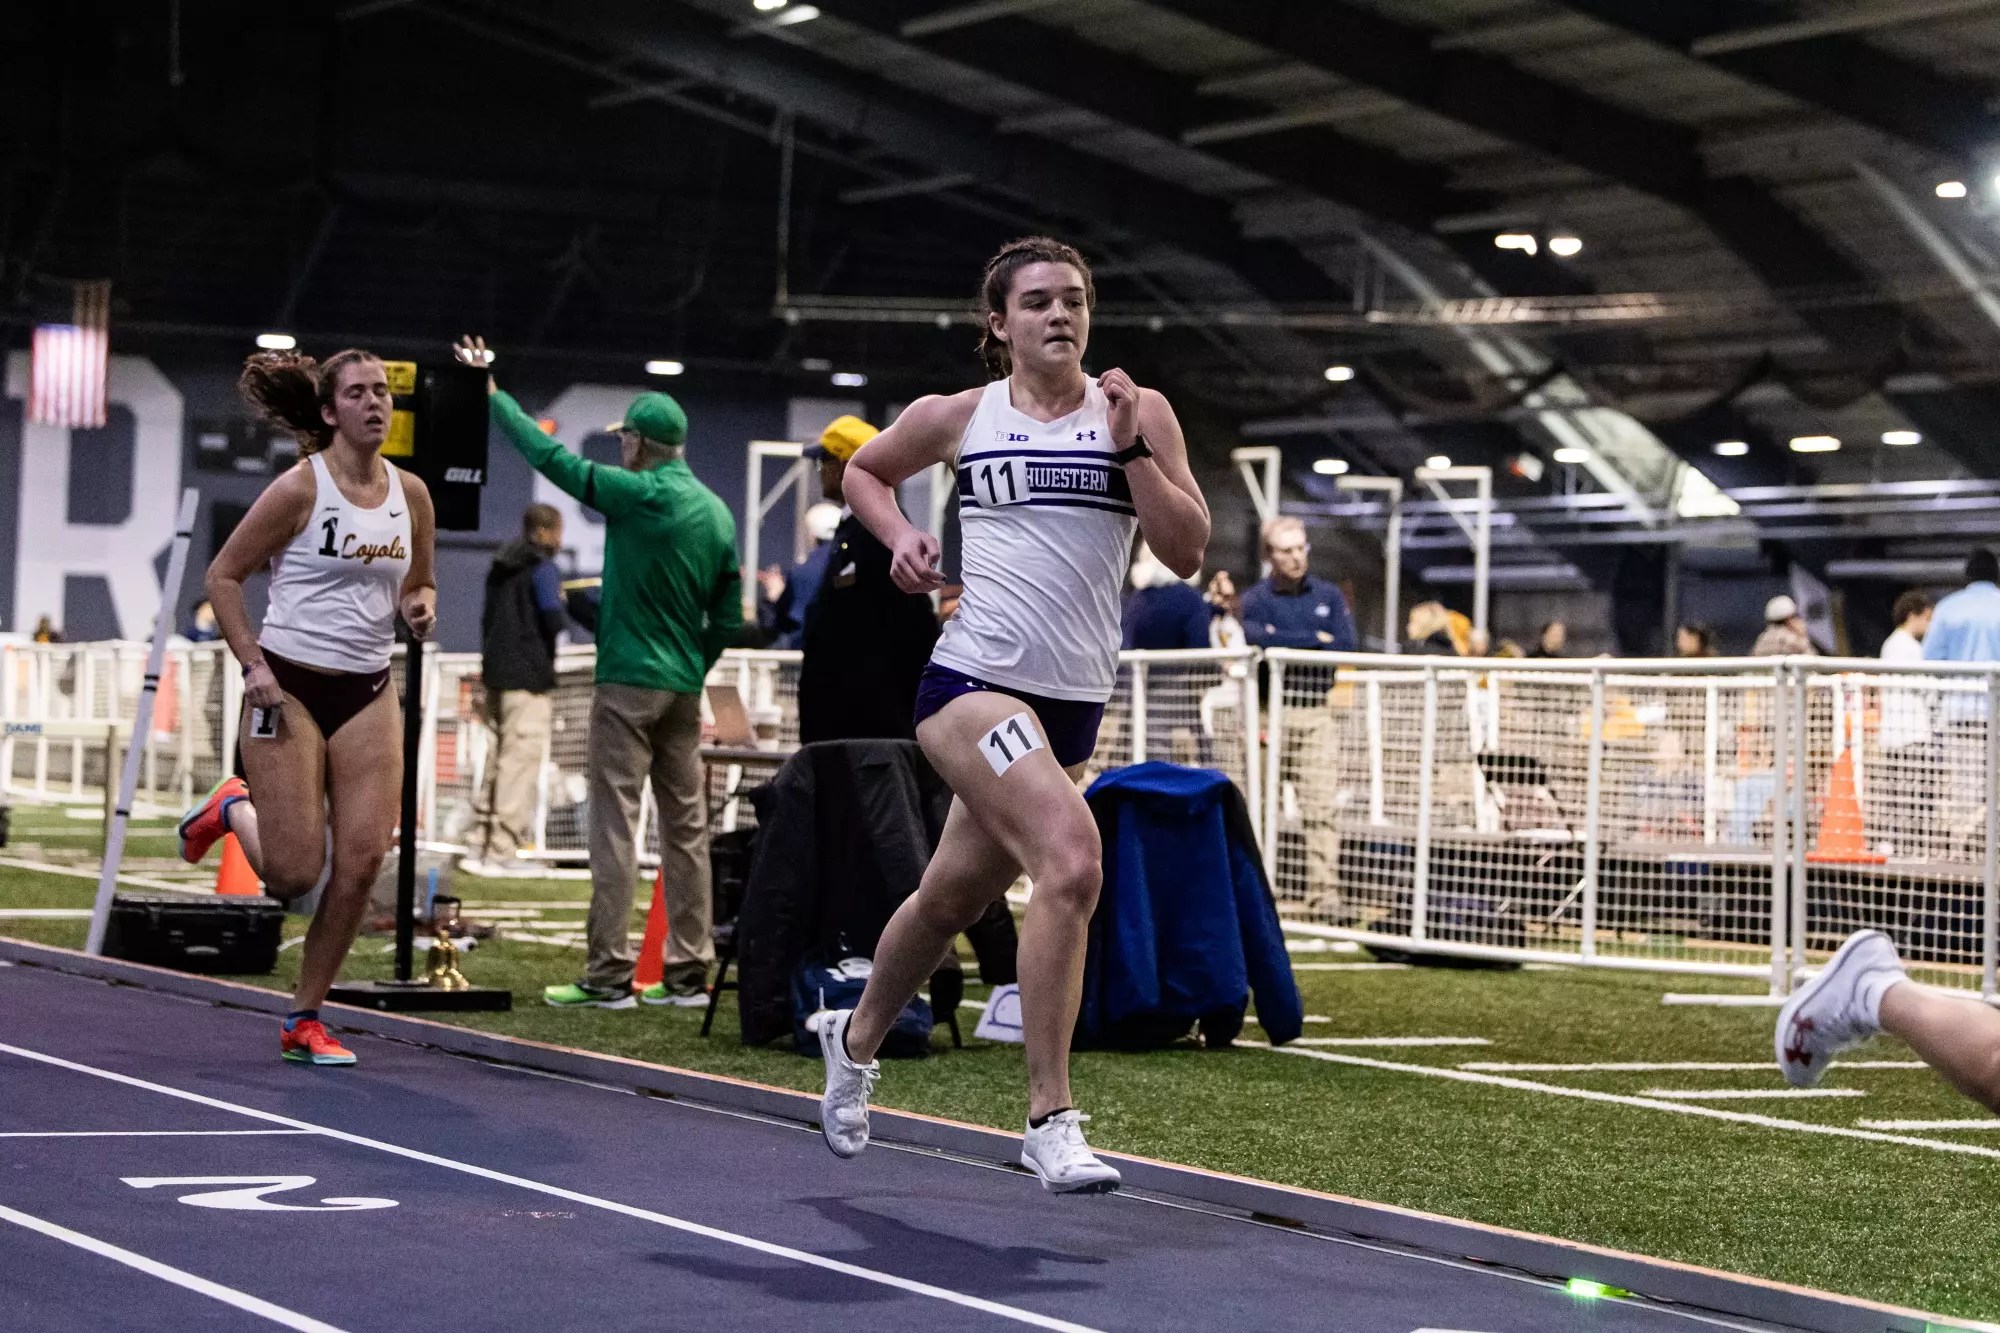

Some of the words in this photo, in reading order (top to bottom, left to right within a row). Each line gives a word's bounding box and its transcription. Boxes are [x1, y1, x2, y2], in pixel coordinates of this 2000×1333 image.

[445, 468, 482, 483] GILL
[981, 460, 1017, 504] 11
[1024, 468, 1109, 491] HWESTERN
[319, 517, 339, 557] 1
[342, 534, 406, 564] Loyola
[257, 707, 274, 734] 1
[990, 719, 1032, 763] 11
[119, 1175, 400, 1211] 2
